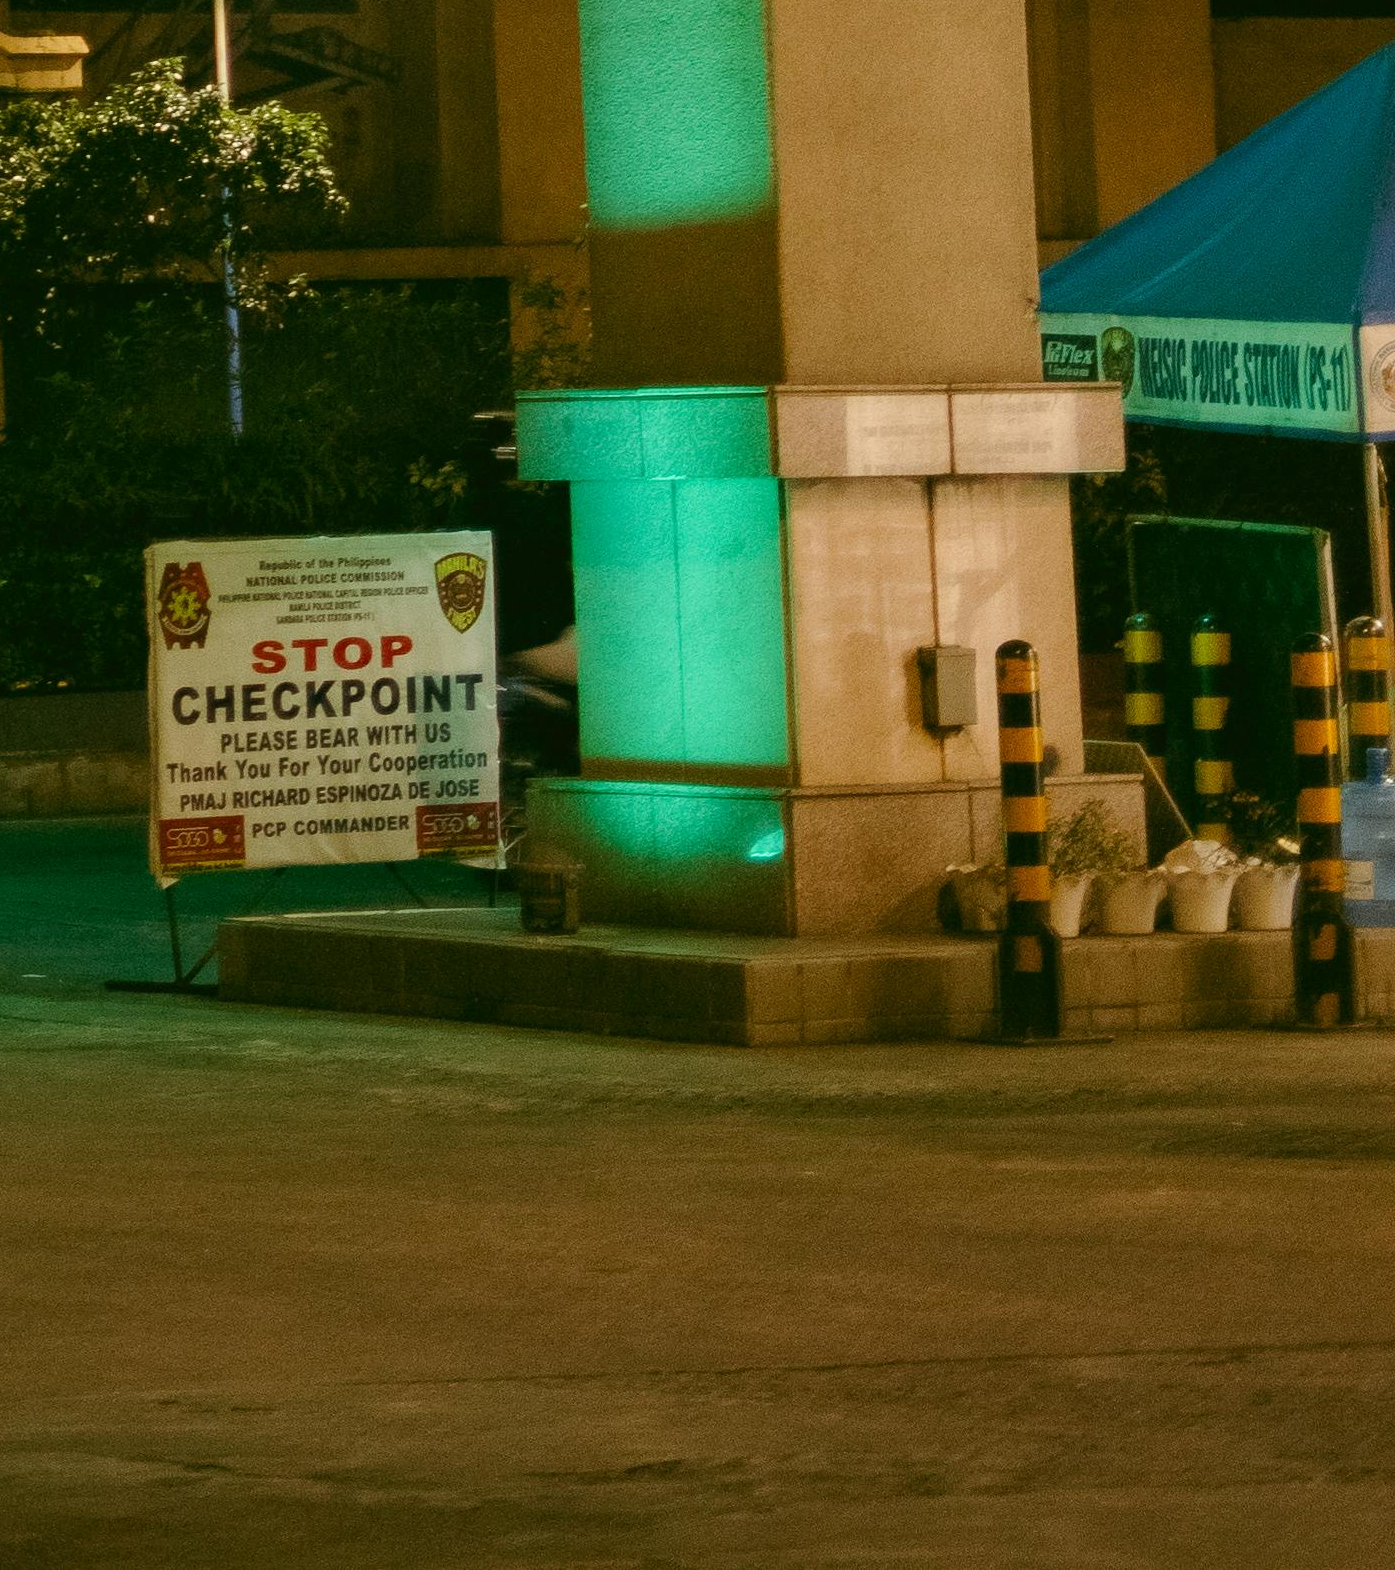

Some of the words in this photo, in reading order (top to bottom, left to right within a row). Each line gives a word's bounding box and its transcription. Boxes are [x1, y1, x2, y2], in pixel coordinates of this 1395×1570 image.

[1139, 337, 1187, 402] MEISIC
[1191, 339, 1240, 406] POLICE
[1243, 342, 1302, 409] STATION
[1305, 342, 1351, 412] (PS-11)
[246, 573, 296, 587] NATIONAL
[300, 572, 336, 584] POLICE
[340, 571, 405, 583] COMMISSION
[259, 560, 301, 572] Republic
[305, 559, 317, 569] of
[319, 558, 334, 568] the
[338, 557, 391, 569] Philippines
[282, 591, 304, 600] POLICE
[383, 587, 403, 595] POLICE
[312, 602, 333, 611] POLICE
[335, 600, 361, 609] DISTRICT
[251, 635, 414, 674] STOP
[171, 673, 483, 725] CHECKPOINT
[220, 730, 298, 753] PLEASE
[306, 727, 358, 750] BEAR
[366, 725, 417, 747] WITH
[424, 723, 451, 743] US
[166, 761, 227, 784] Thank
[235, 758, 271, 780] You
[278, 756, 310, 778] For
[317, 754, 361, 776] Your
[368, 748, 488, 775] Cooperation
[179, 792, 227, 812] PMAJ
[233, 787, 310, 809] RICHARD
[316, 783, 401, 805] ESPINOZA
[408, 781, 431, 800] DE
[435, 778, 480, 799] JOSE
[251, 821, 287, 839] PCP
[294, 815, 409, 836] COMMANDER
